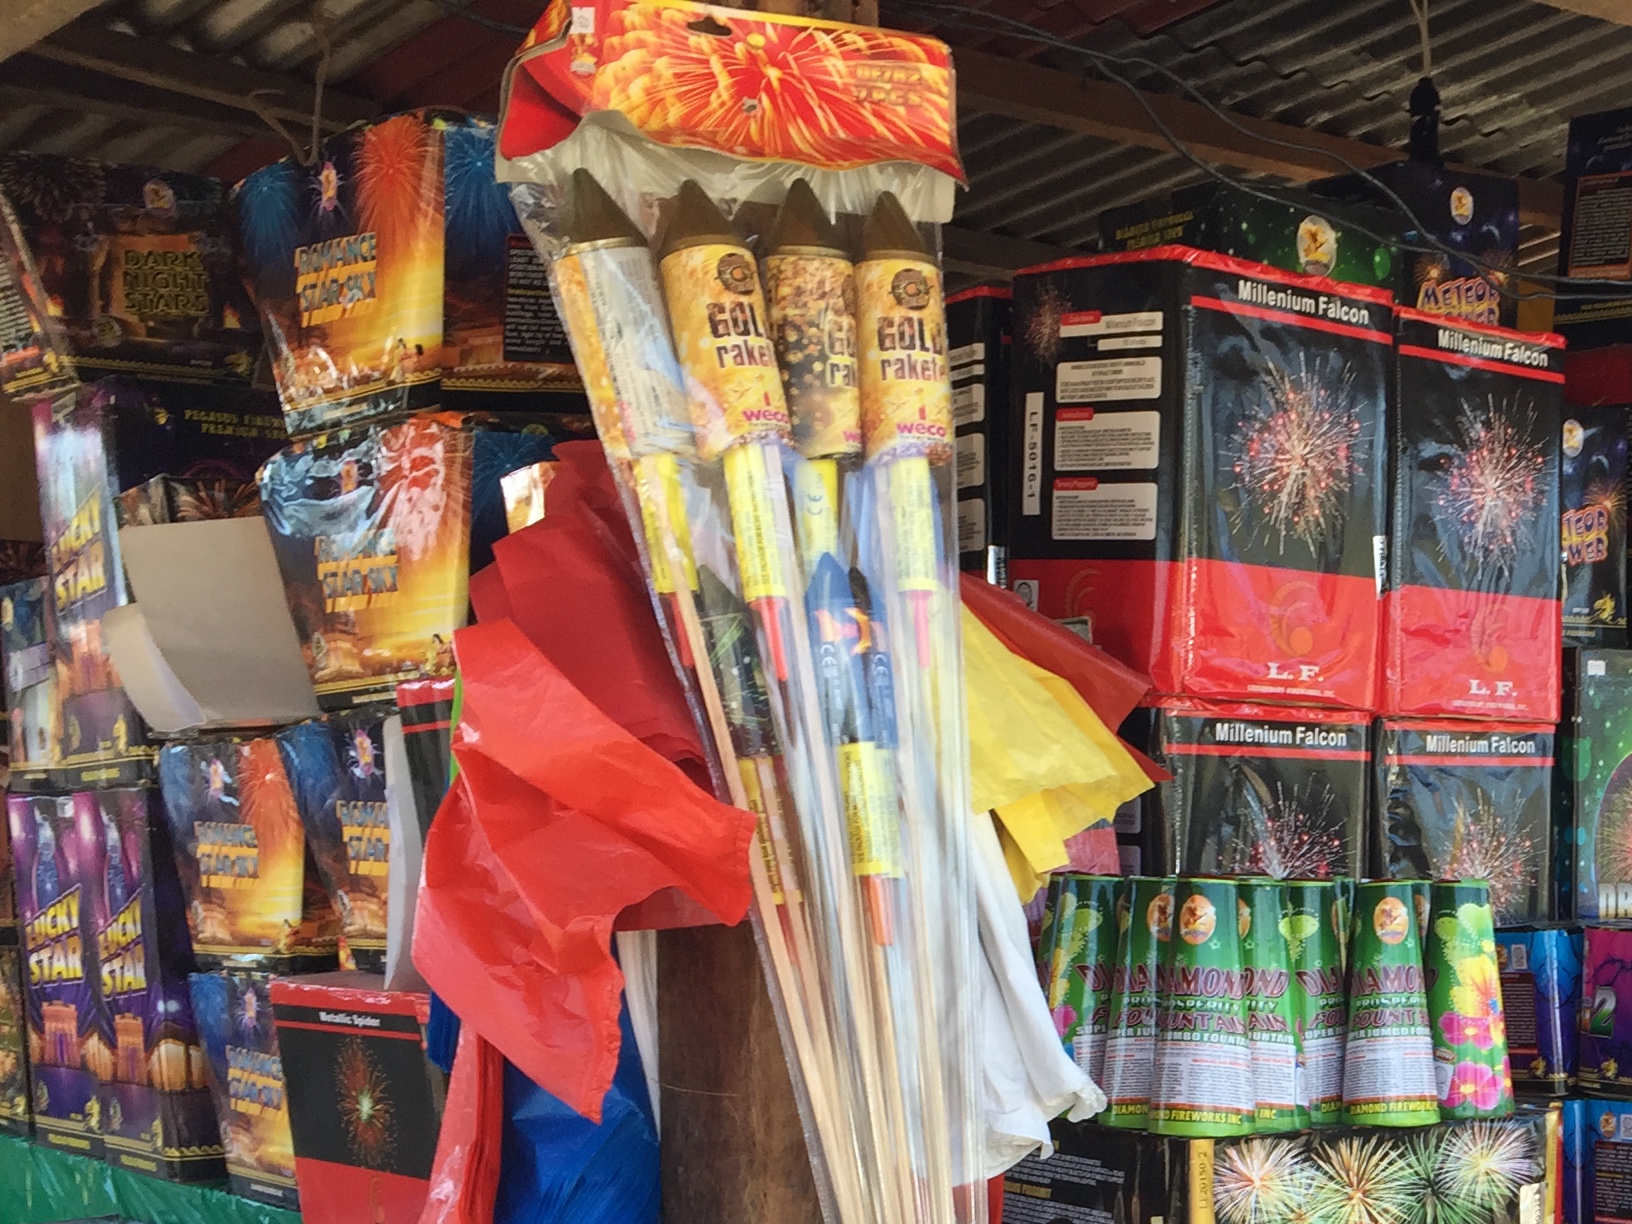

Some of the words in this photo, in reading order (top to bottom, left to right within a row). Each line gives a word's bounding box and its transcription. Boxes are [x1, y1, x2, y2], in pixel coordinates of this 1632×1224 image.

[124, 250, 203, 270] DARK
[1238, 279, 1315, 315] Millenium
[1318, 296, 1369, 325] Falcon
[706, 300, 765, 338] GOL
[716, 340, 777, 369] rake
[1438, 329, 1503, 359] Millenium
[1503, 343, 1549, 369] Falcon
[1215, 722, 1293, 746] Millenium
[1296, 726, 1347, 748] Falcon
[1426, 735, 1489, 755] Millenium
[1491, 736, 1536, 756] Falcon
[1171, 1111, 1227, 1124] FIREWORKS
